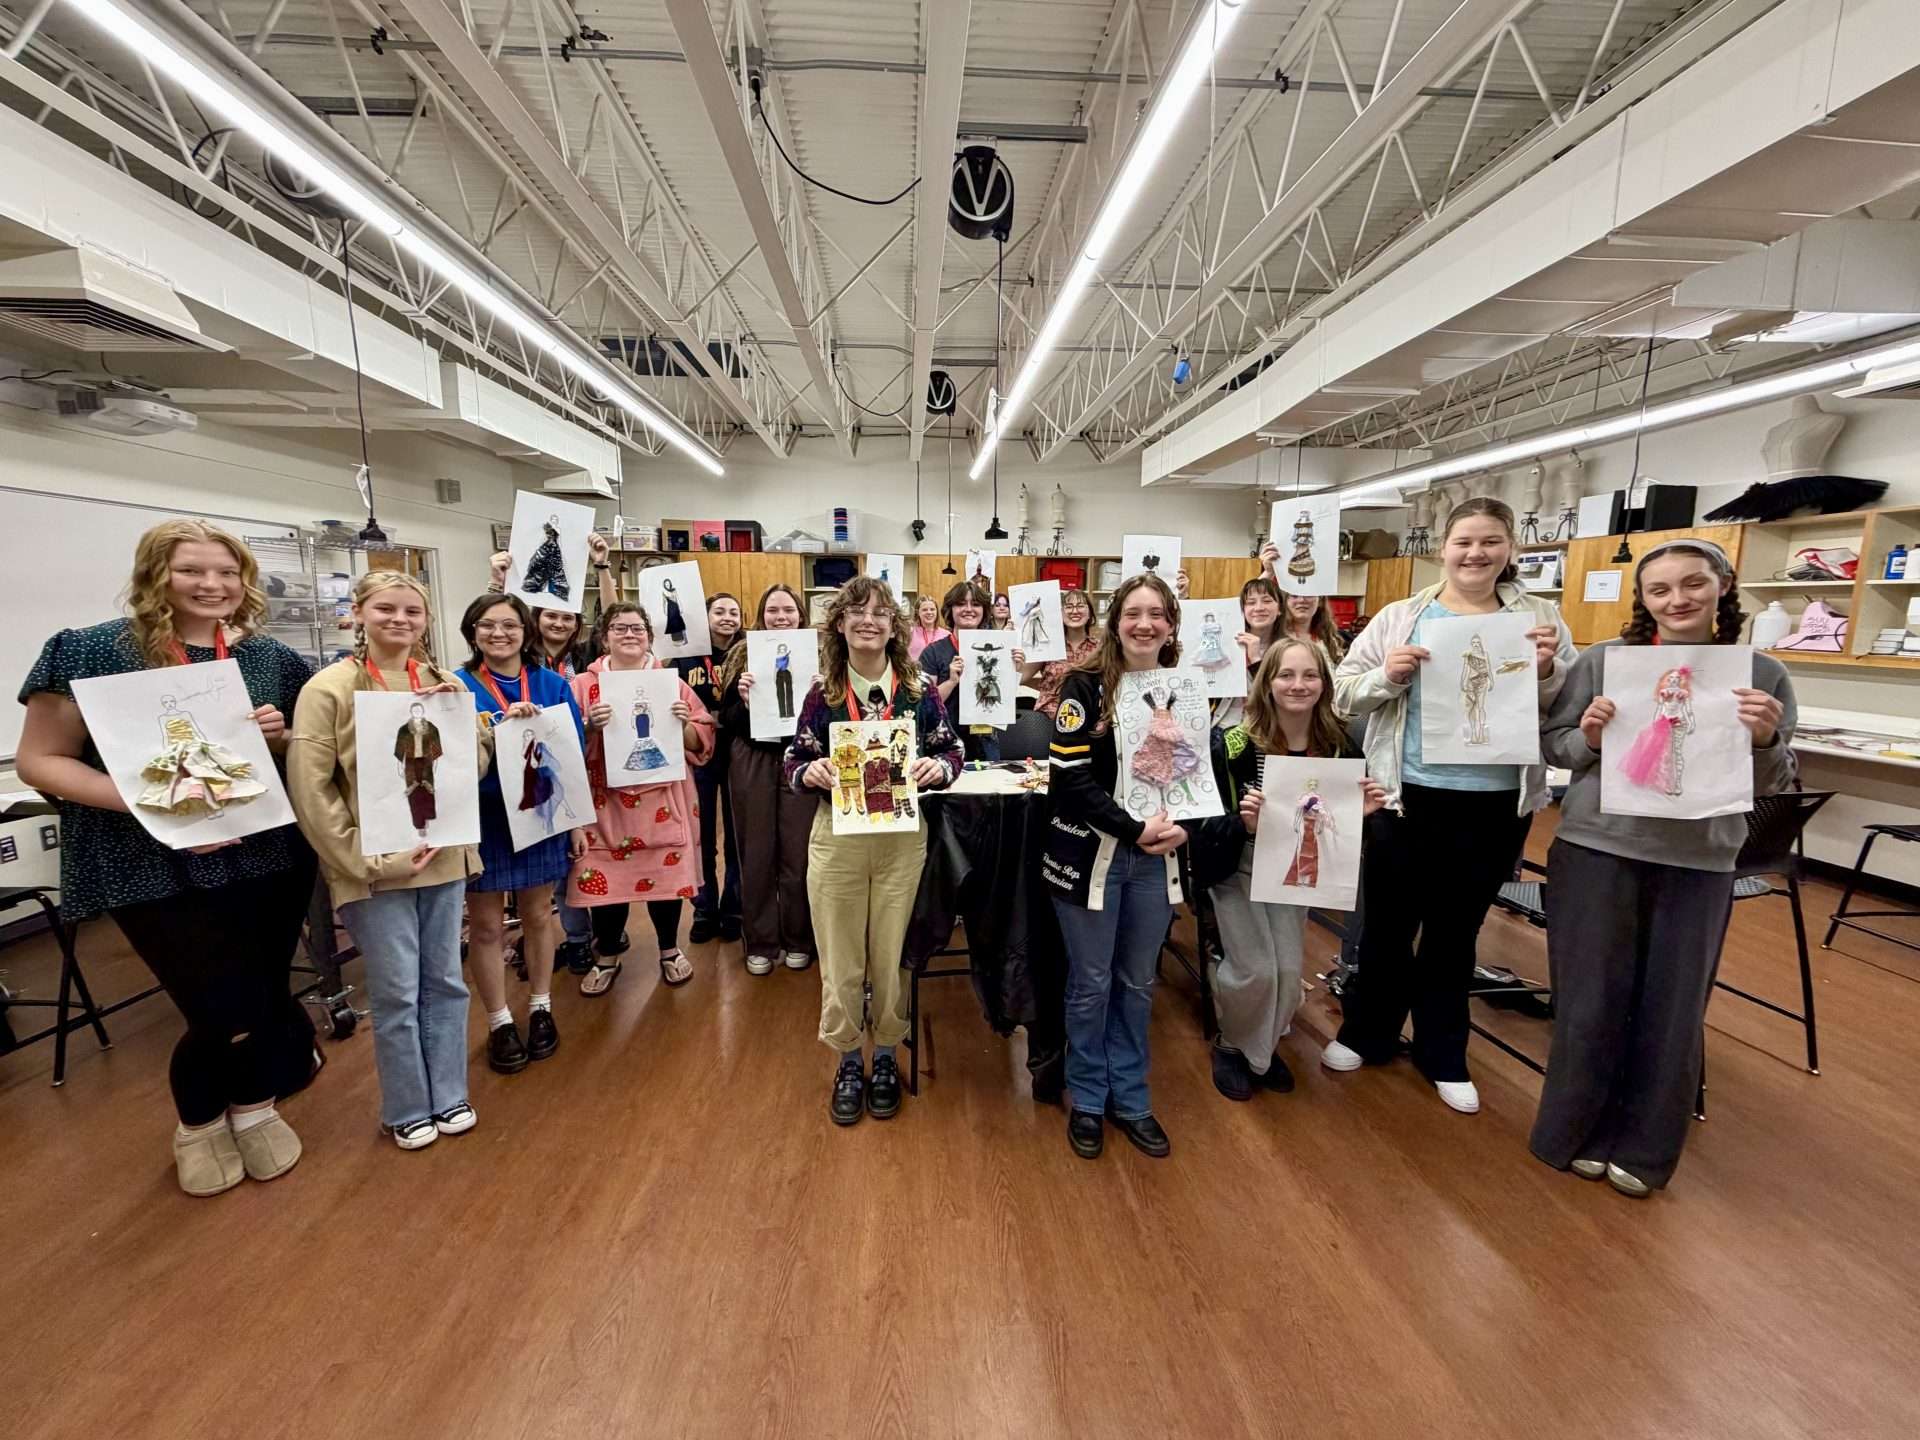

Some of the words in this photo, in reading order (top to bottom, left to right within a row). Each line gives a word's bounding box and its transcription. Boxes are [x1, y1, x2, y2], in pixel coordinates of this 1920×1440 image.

[1050, 816, 1090, 838] President
[1042, 866, 1073, 890] Historian
[1062, 865, 1080, 879] Rep
